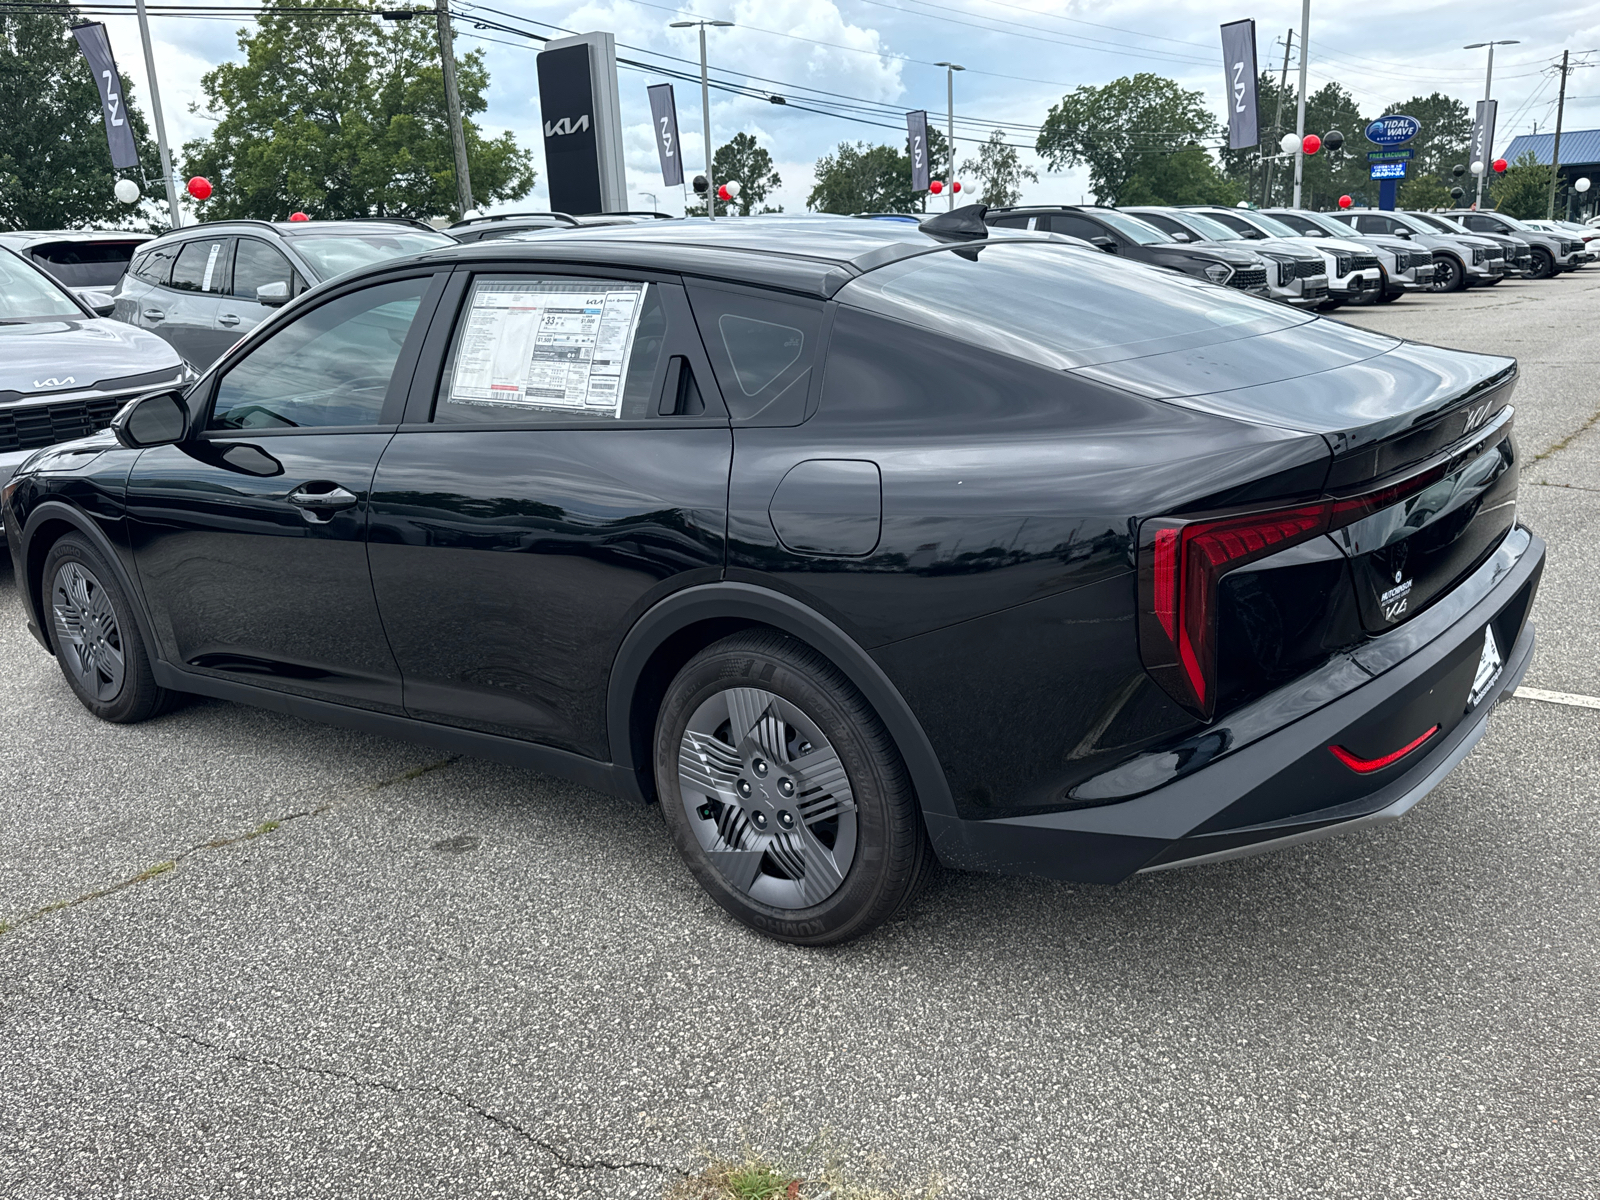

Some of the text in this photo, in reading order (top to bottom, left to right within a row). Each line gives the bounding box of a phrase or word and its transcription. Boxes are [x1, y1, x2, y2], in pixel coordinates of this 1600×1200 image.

[102, 69, 125, 127] KIA
[1233, 61, 1247, 113] KIA
[544, 114, 590, 137] KIA
[1384, 119, 1409, 129] TIDAL
[1387, 127, 1414, 136] WAVE
[660, 116, 674, 157] KIA
[914, 135, 923, 169] KIA
[1384, 150, 1410, 158] VACUUMS
[545, 316, 556, 325] 33
[33, 376, 76, 388] KIA
[1463, 400, 1493, 434] KIA
[53, 545, 81, 559] KUMHO
[1381, 578, 1413, 602] HUTCHINSON
[1385, 597, 1407, 621] K4
[753, 914, 826, 936] KUMHO
